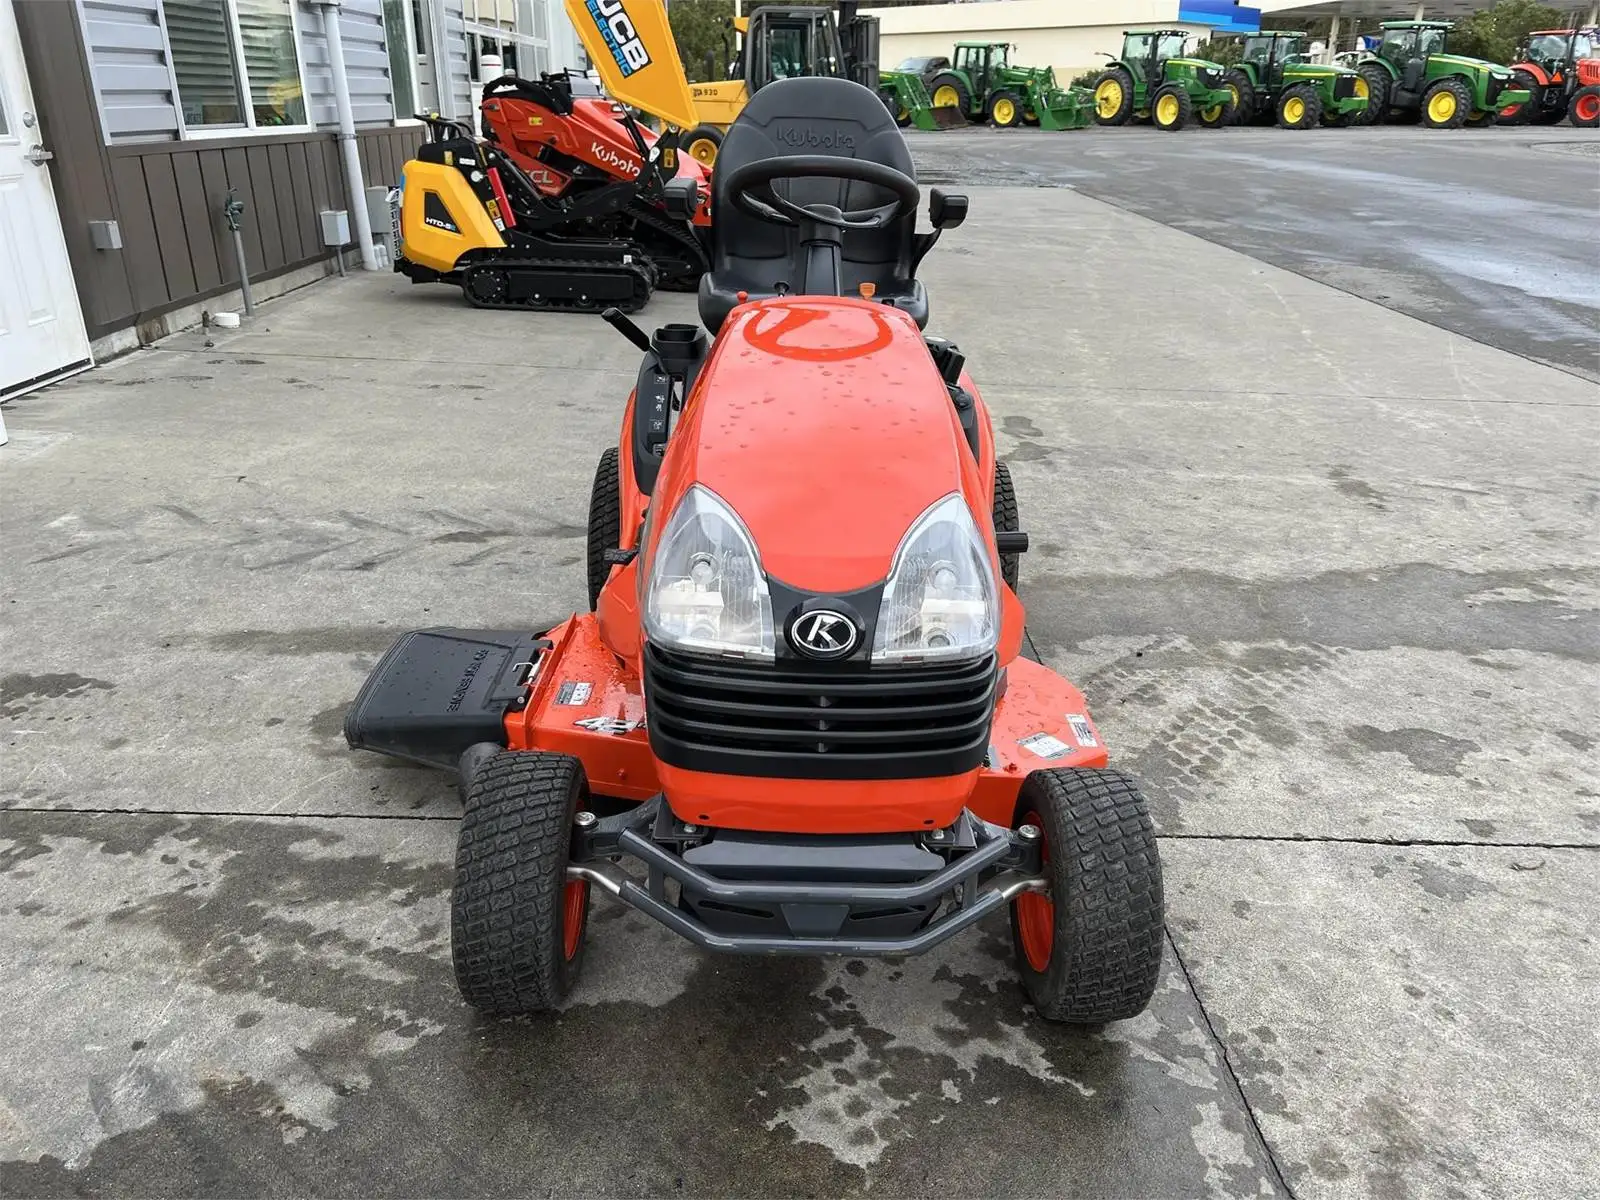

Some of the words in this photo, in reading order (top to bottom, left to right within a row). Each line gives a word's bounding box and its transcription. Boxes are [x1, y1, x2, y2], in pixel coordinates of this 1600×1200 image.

[596, 0, 649, 70] JCB
[776, 125, 856, 149] Kubota
[591, 141, 641, 177] Kubota
[524, 169, 553, 184] CL
